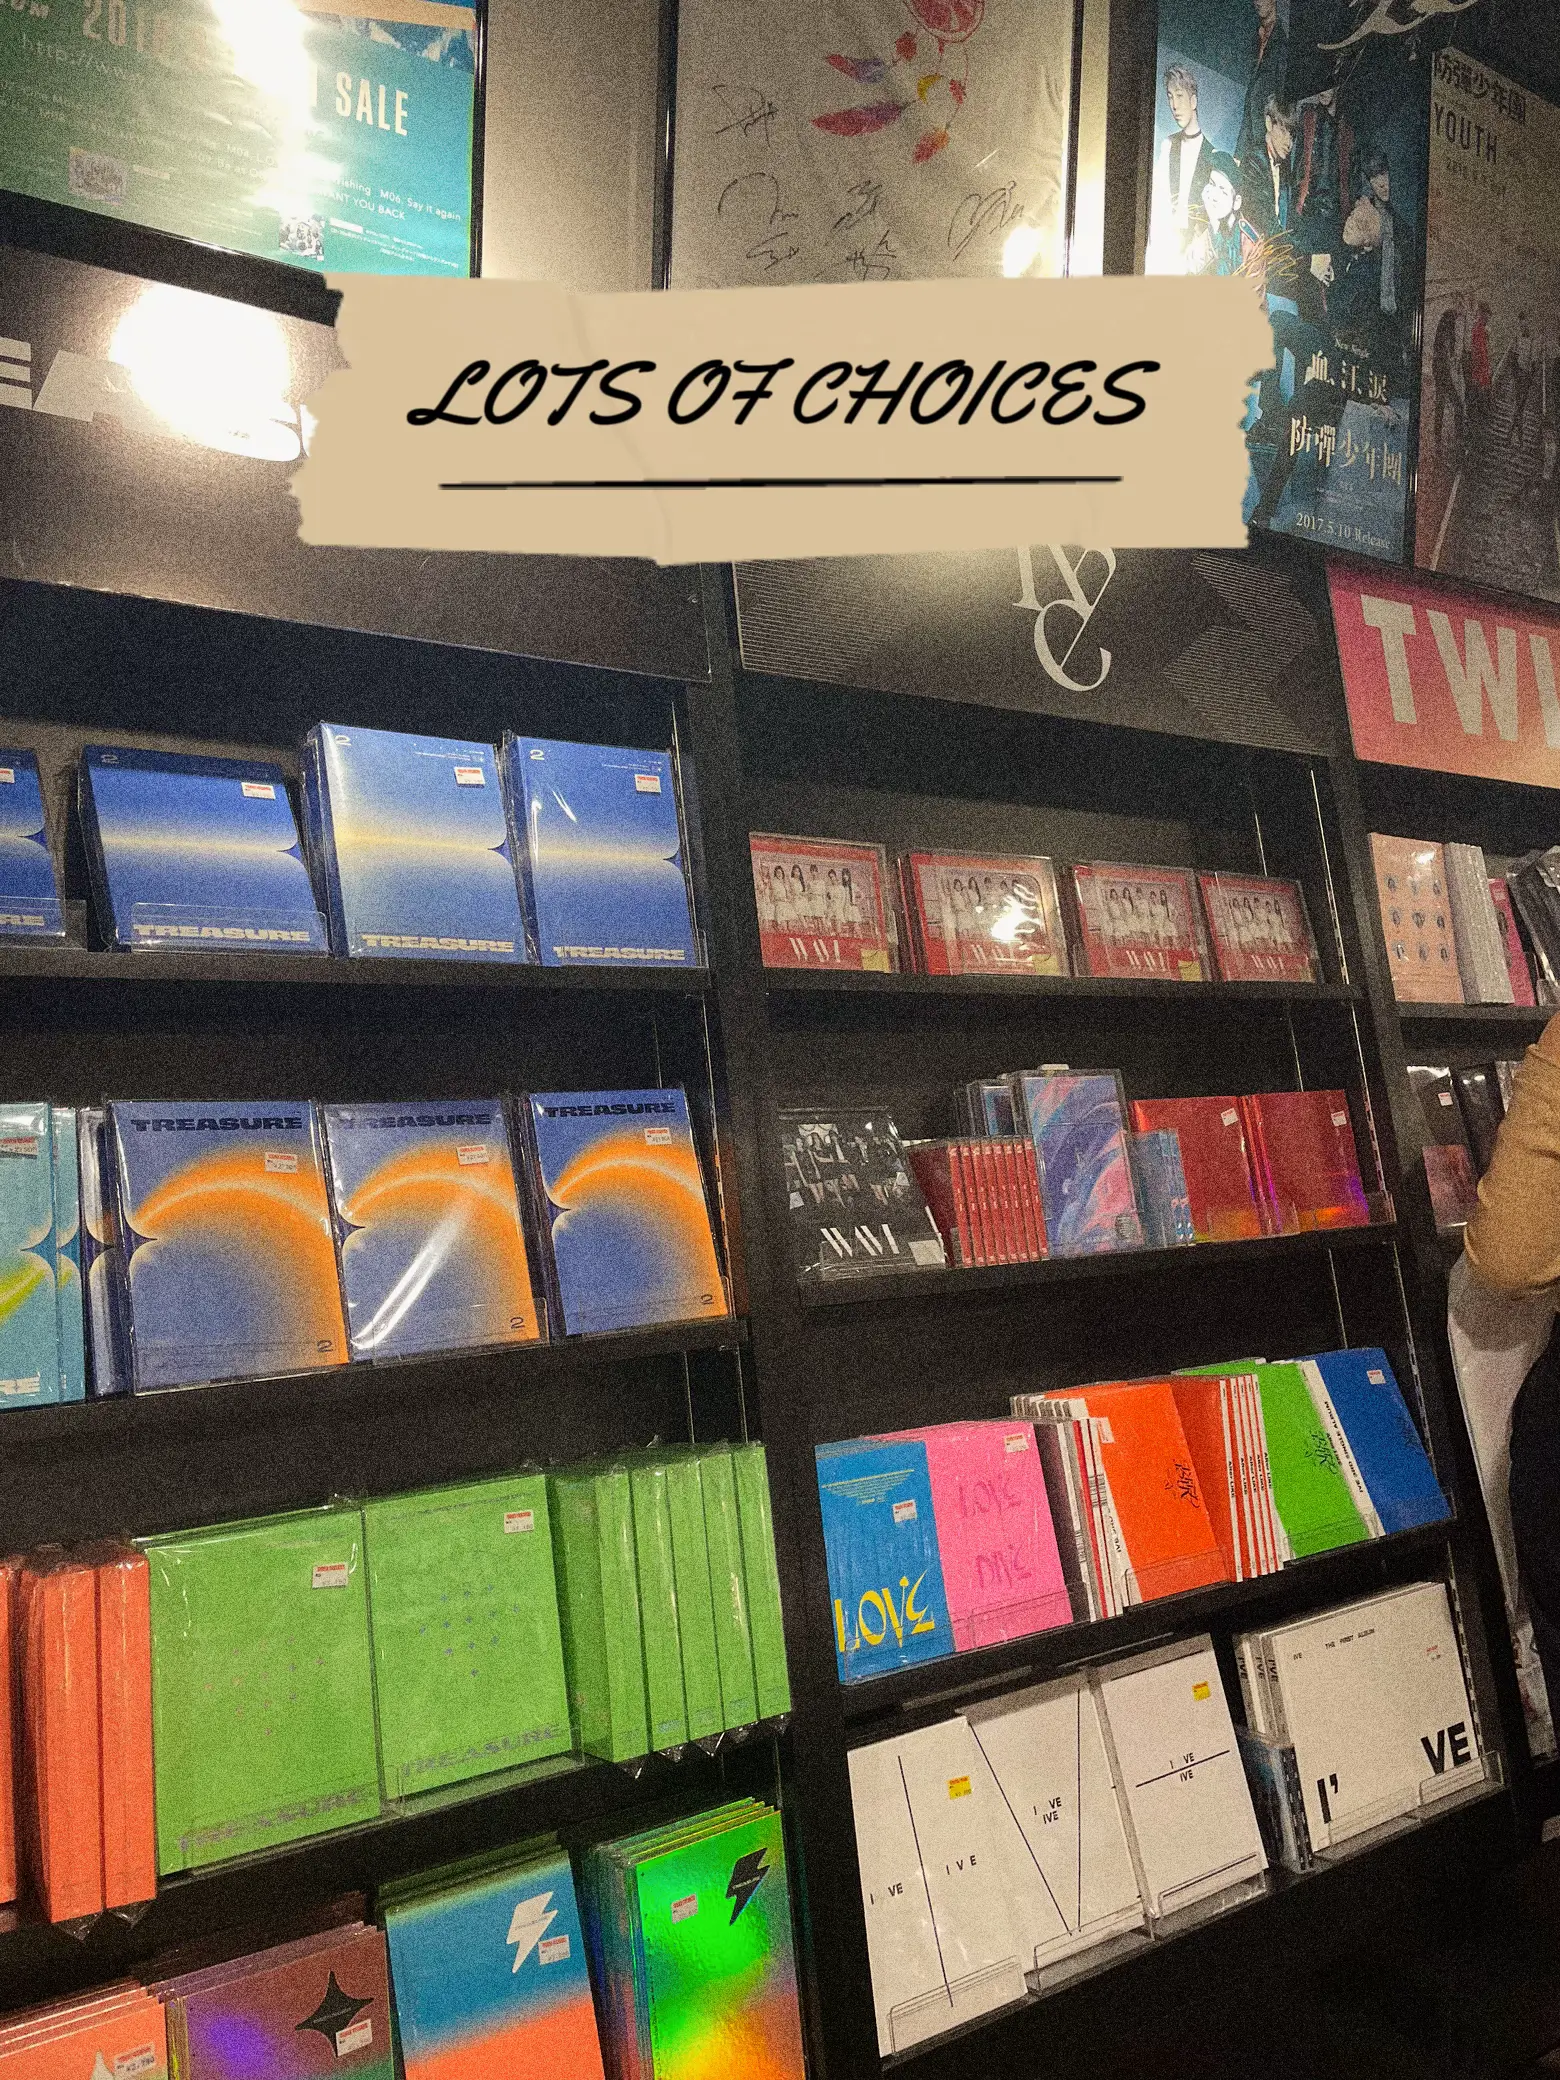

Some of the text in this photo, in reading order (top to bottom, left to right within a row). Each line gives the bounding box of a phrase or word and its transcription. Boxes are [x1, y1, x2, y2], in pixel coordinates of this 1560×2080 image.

[335, 71, 409, 137] SALE
[1434, 102, 1498, 165] YOUTH
[354, 198, 375, 212] YOU
[378, 204, 405, 220] BACK
[407, 197, 424, 212] Say
[436, 208, 462, 221] again
[132, 923, 311, 942] TREASURE
[361, 933, 514, 953] TREASURE
[553, 945, 686, 961] TREASURE
[543, 1101, 676, 1118] TREASURE
[130, 1116, 303, 1132] TREASURE
[834, 1569, 936, 1653] LOVE
[1420, 1721, 1472, 1776] VE
[1179, 1769, 1194, 1783] IVE
[1042, 1810, 1059, 1825] IVE
